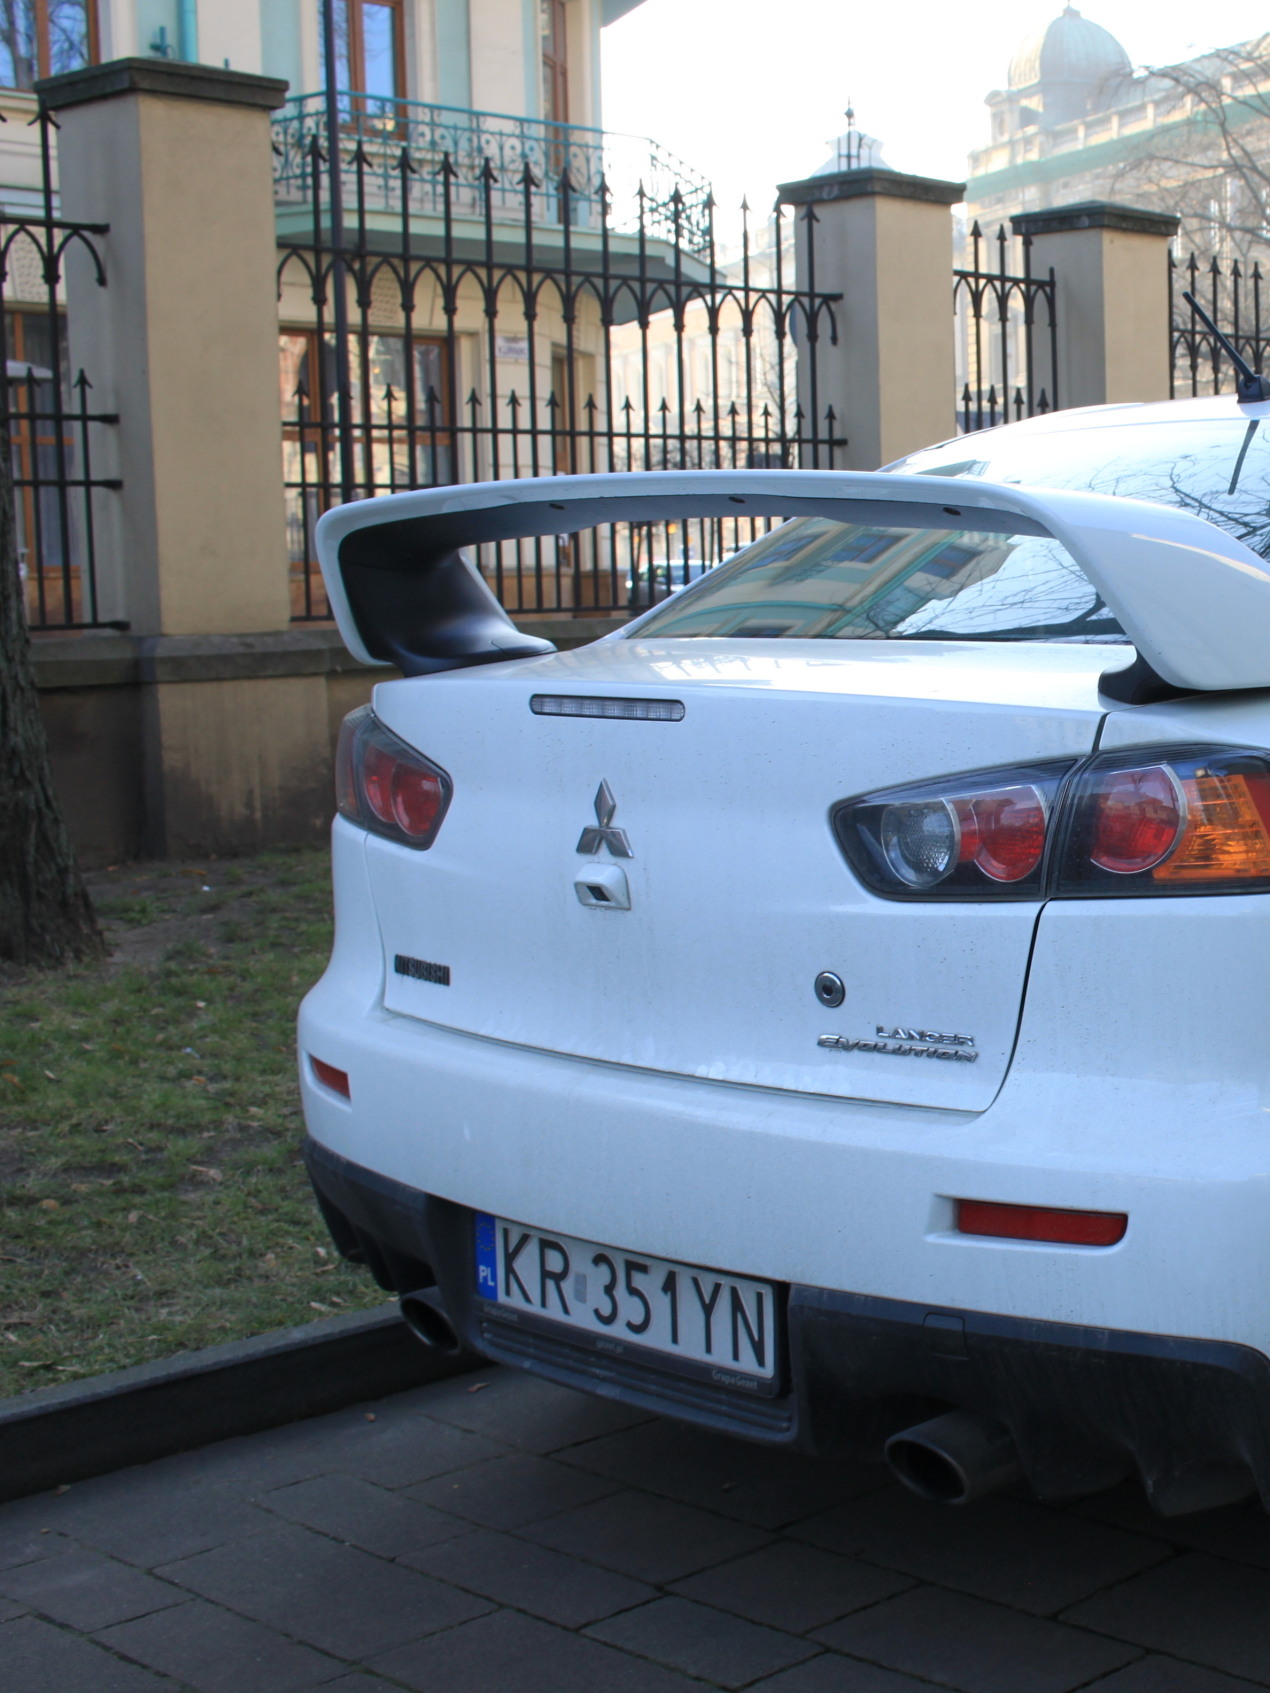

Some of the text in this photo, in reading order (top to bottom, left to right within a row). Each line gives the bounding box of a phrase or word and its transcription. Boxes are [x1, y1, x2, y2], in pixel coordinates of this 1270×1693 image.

[816, 1033, 979, 1063] EVOLUTION
[875, 1024, 976, 1047] LANCER
[479, 1264, 495, 1287] PL
[502, 1226, 766, 1369] KR 351YN
